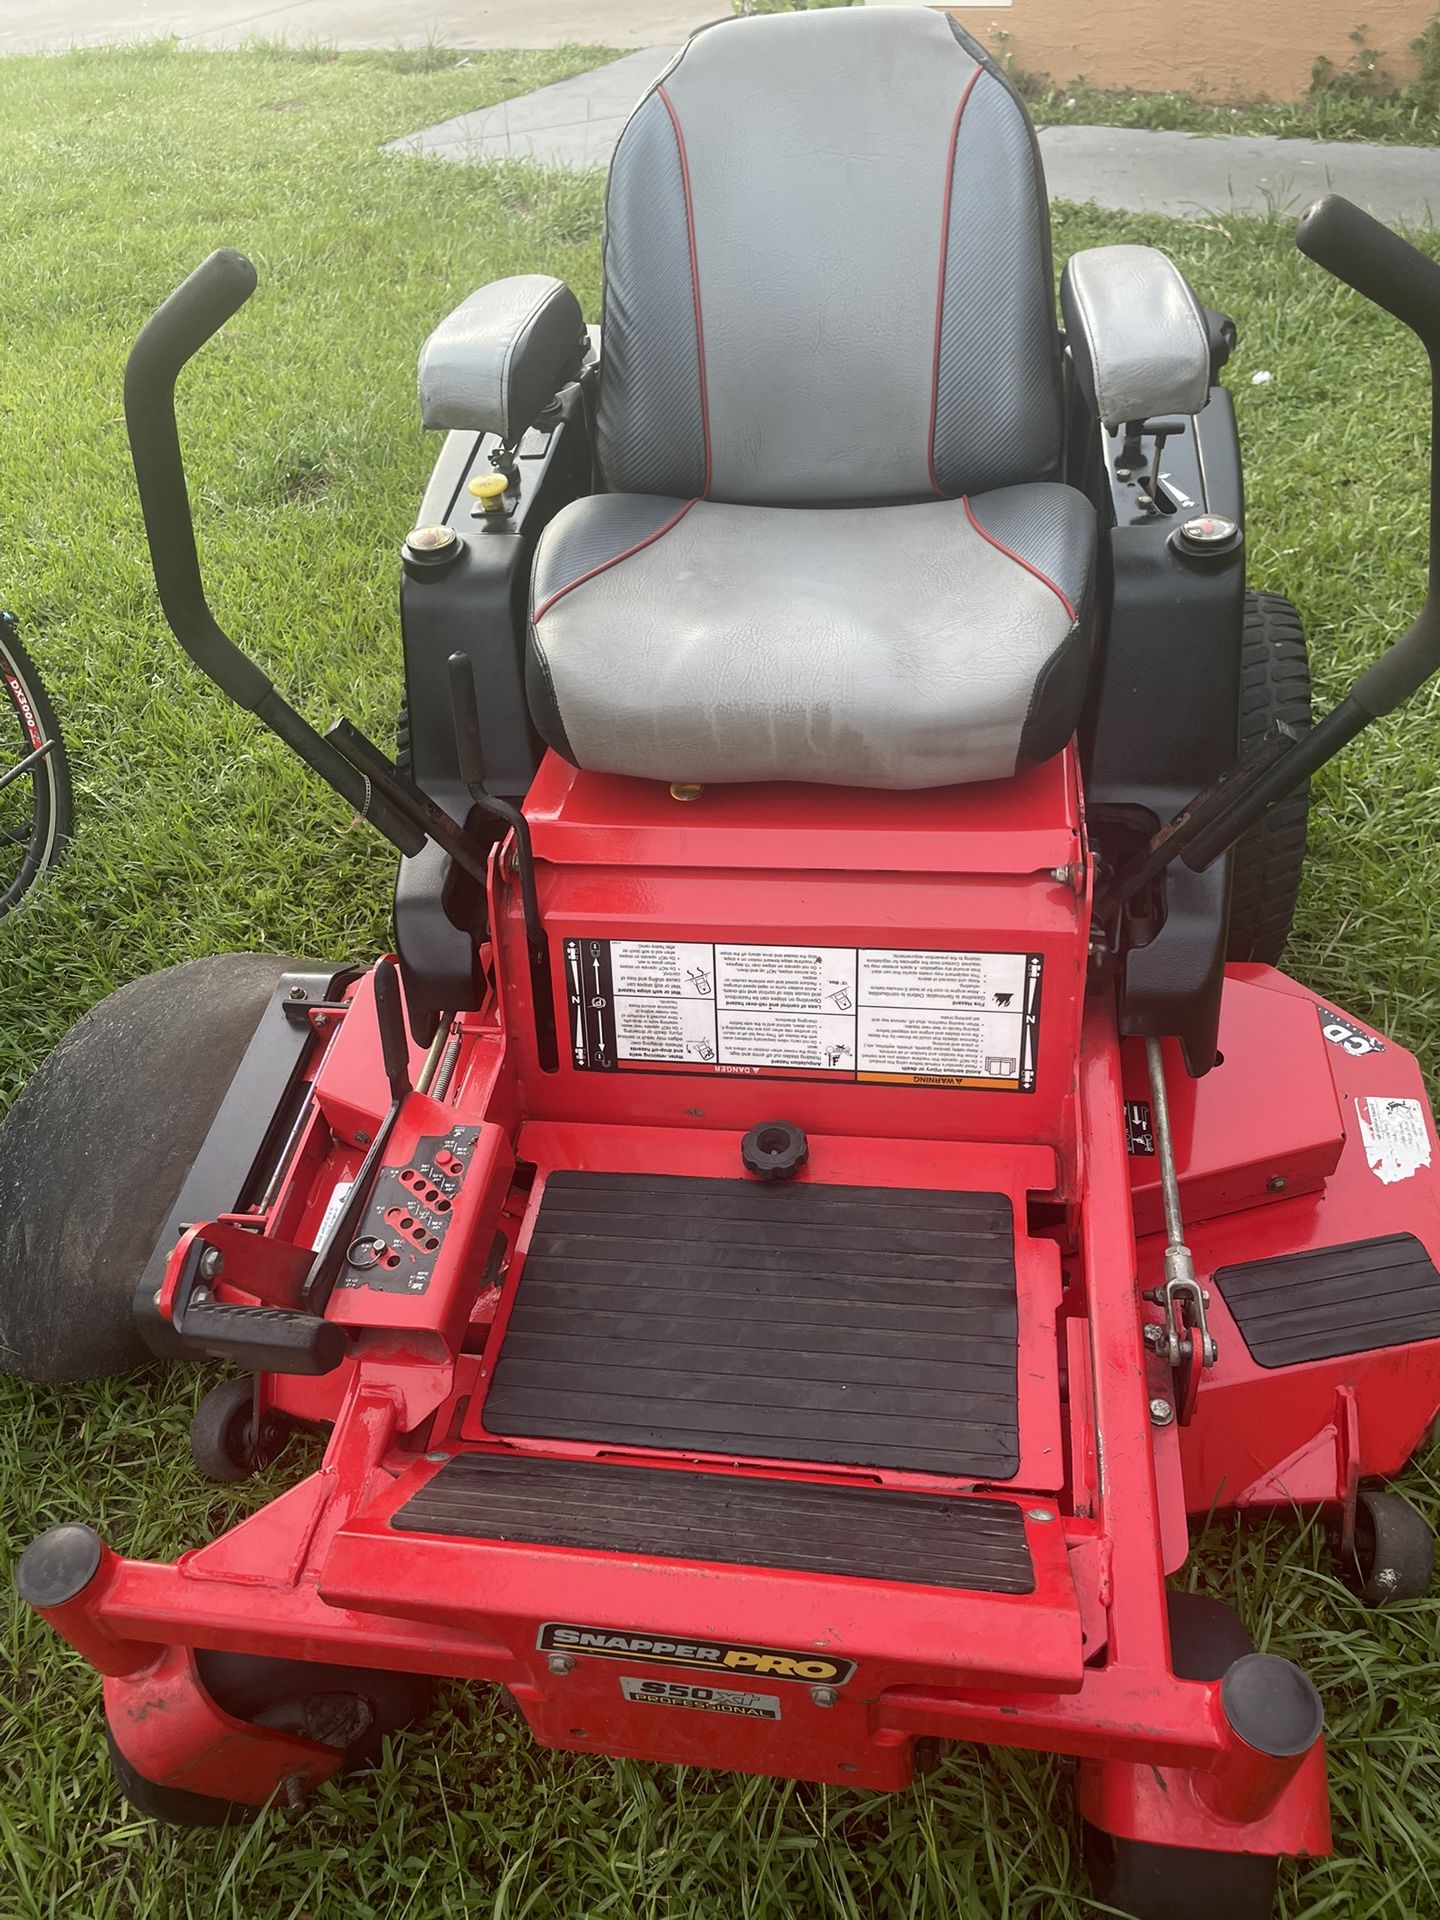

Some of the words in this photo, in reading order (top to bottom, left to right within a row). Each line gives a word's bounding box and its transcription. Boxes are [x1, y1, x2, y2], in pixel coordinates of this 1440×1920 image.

[10, 679, 35, 728] DX3000
[571, 995, 579, 1003] N
[1026, 1014, 1034, 1023] N
[641, 1039, 663, 1047] dropping
[714, 1065, 749, 1073] DANGER
[552, 1628, 722, 1662] SNAPPER
[722, 1650, 838, 1680] PRO
[634, 1693, 772, 1718] PROFESSIONAL
